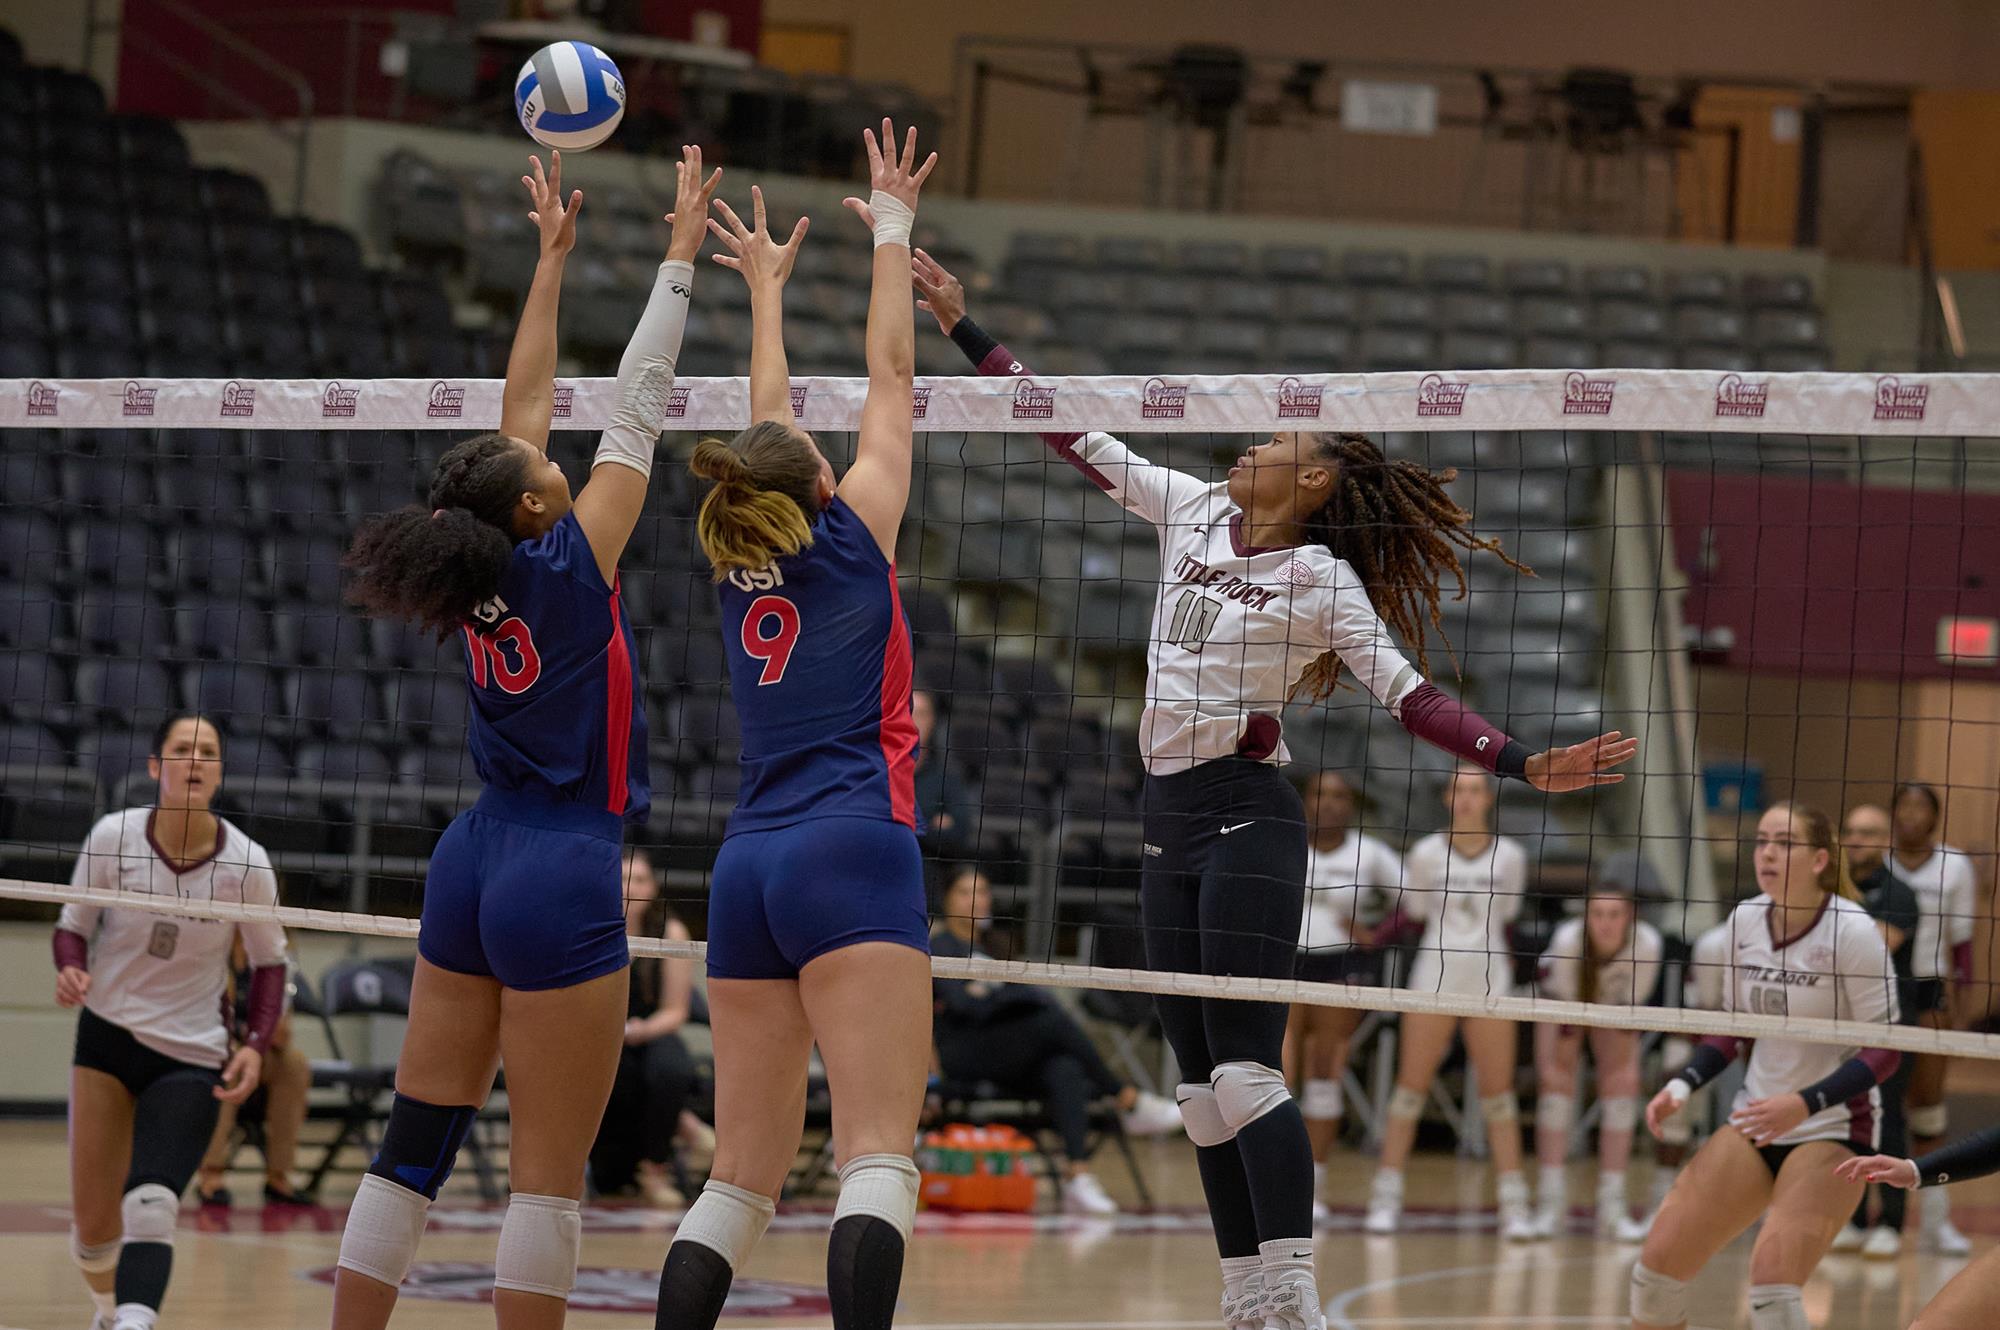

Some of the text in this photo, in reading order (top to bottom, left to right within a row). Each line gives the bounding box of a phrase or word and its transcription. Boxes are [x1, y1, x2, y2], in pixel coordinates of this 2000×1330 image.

[1296, 397, 1320, 405] ROCK
[1438, 394, 1463, 403] ROCK
[1584, 392, 1611, 401] ROCK
[1737, 395, 1764, 404] ROCK
[1030, 399, 1052, 407] ROCK
[1160, 398, 1184, 406] ROCK
[1896, 397, 1925, 406] ROCK
[1215, 576, 1280, 613] ROCK
[1166, 588, 1223, 655] 10
[741, 595, 801, 686] 9
[463, 616, 542, 695] 10
